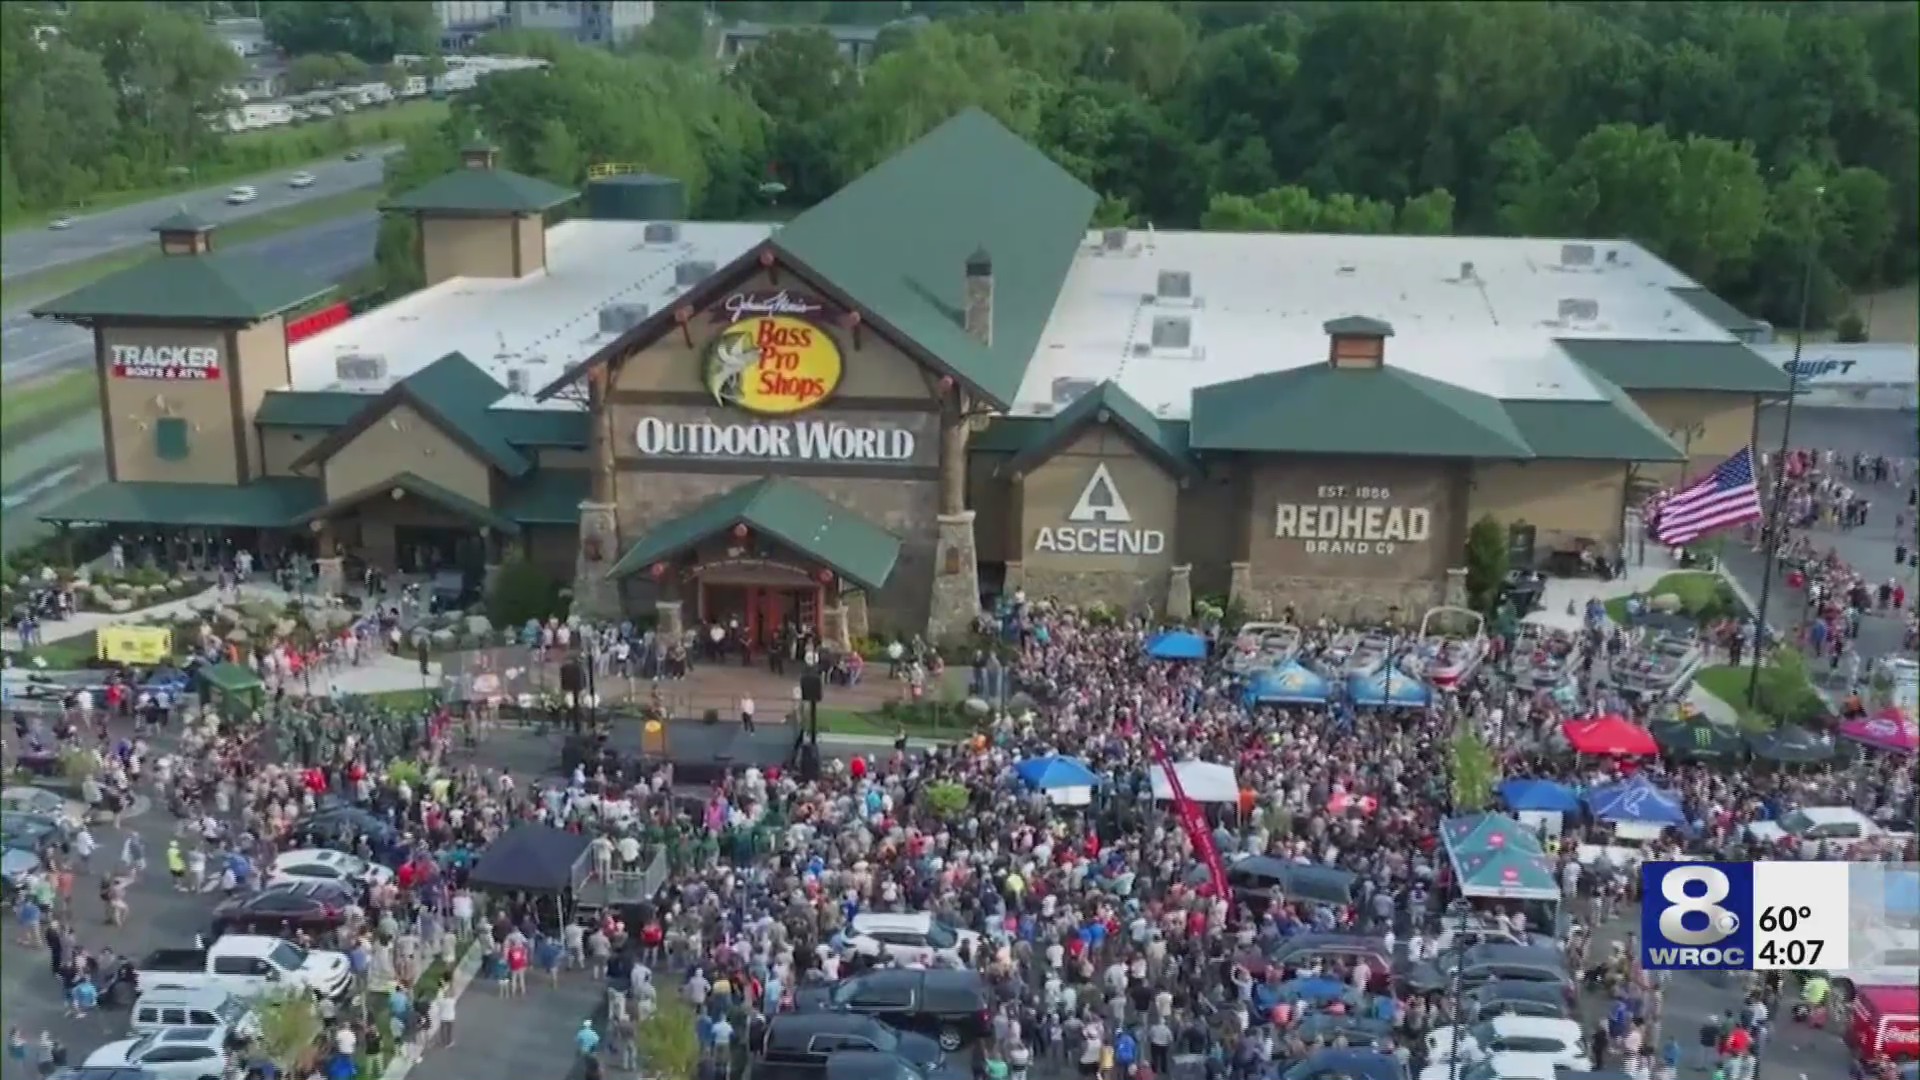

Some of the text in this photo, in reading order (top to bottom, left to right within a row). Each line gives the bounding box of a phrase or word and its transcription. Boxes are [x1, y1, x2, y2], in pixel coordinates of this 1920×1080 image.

[757, 320, 812, 347] Bass
[111, 345, 218, 367] TRACKER
[758, 346, 800, 371] Pro
[126, 367, 164, 378] BOATS
[757, 371, 825, 402] Shops
[636, 416, 915, 460] OUTDOOR WORLD
[1275, 503, 1430, 541] REDHEAD
[1034, 526, 1165, 555] ASCEND
[1305, 540, 1369, 554] BRAND
